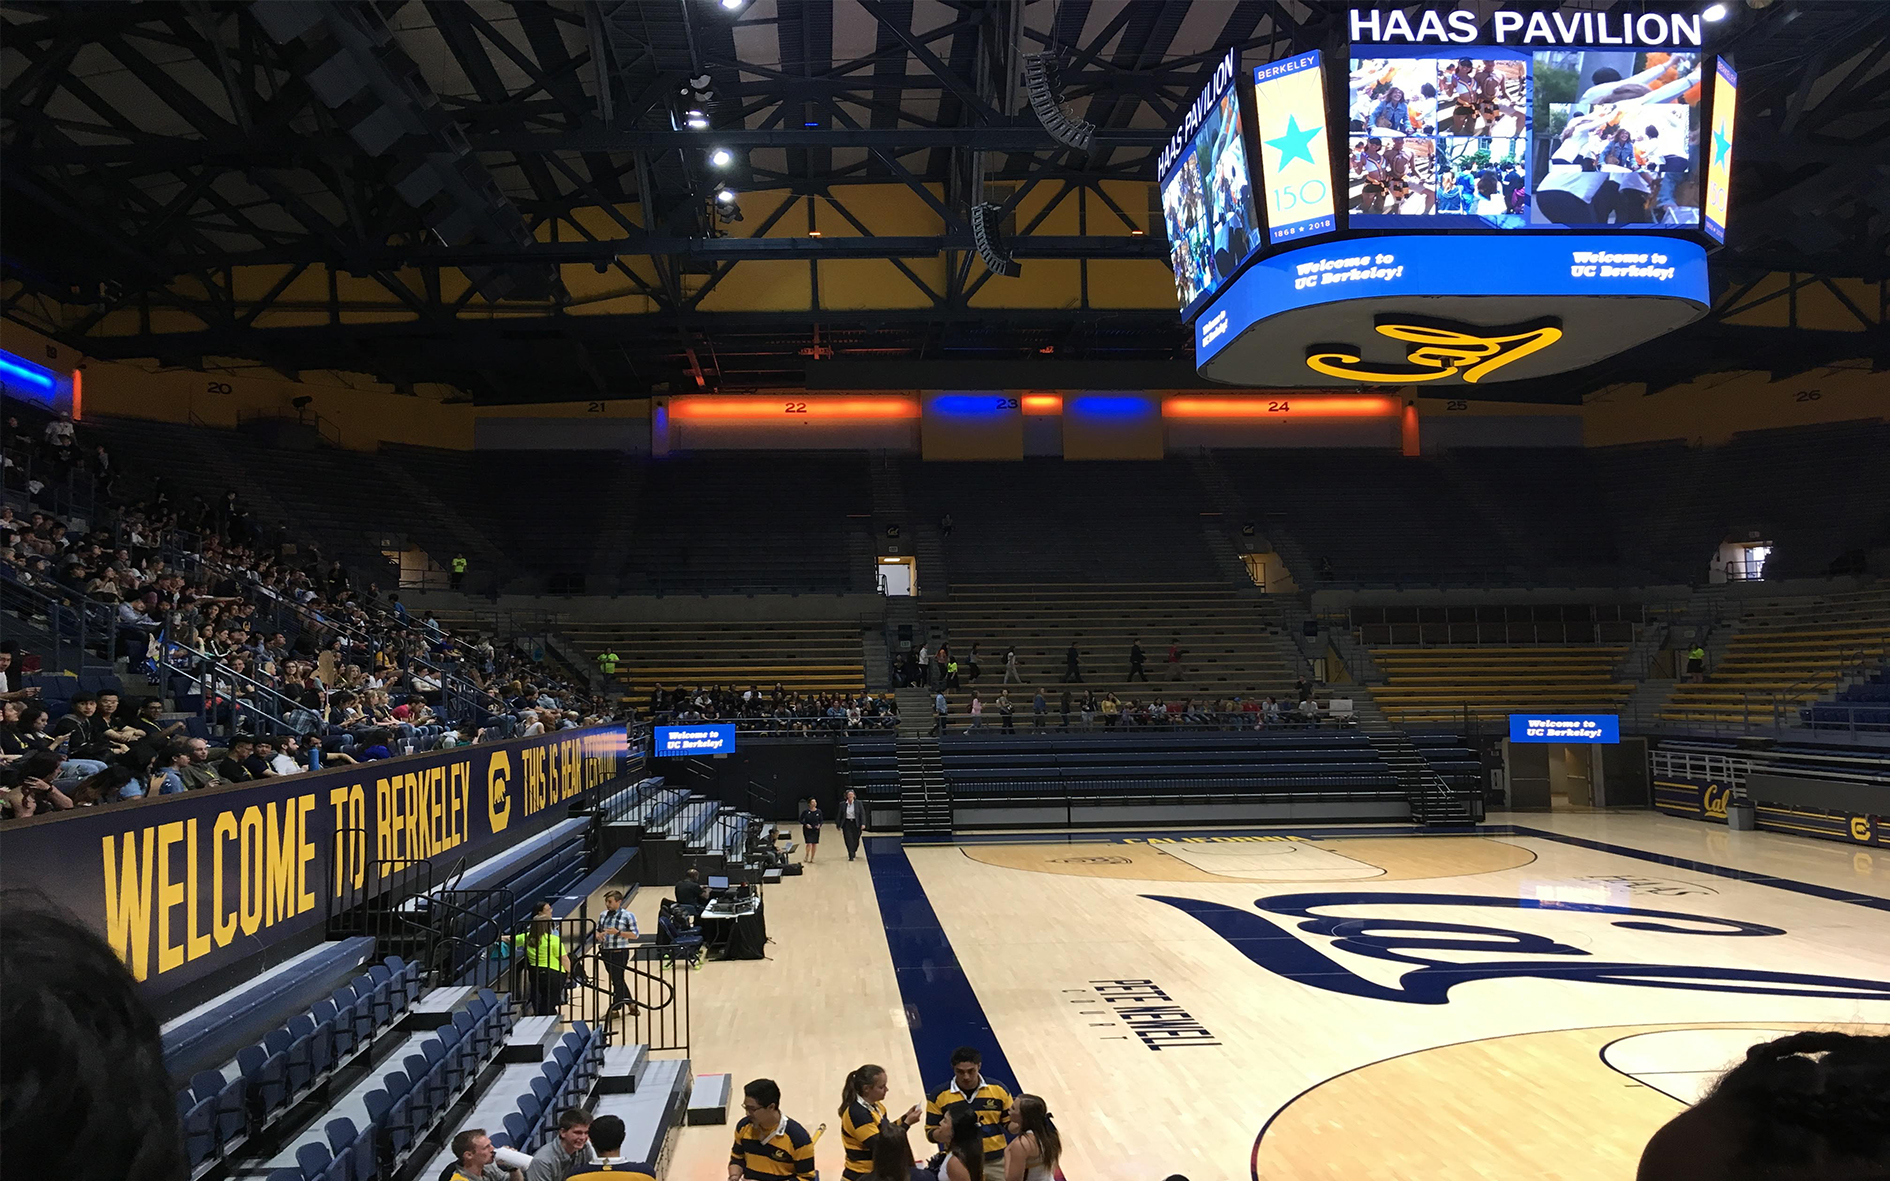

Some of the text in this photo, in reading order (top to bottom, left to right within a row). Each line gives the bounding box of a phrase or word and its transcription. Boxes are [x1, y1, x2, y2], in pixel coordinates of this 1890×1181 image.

[1350, 9, 1702, 46] HAAS PAVILION
[1258, 56, 1315, 80] BERKELEY
[1157, 47, 1234, 181] HAAS PAVILION
[1273, 179, 1327, 211] 150
[1273, 219, 1331, 238] 1868 2018
[1296, 253, 1394, 276] Welcome to
[1572, 251, 1668, 265] Welcome to
[1294, 265, 1404, 290] UC Berkeley!
[1570, 264, 1675, 281] UC Berkeley!
[207, 382, 232, 395] 20
[1795, 390, 1821, 402] 26
[587, 402, 606, 413] 21
[785, 400, 807, 412] 22
[996, 398, 1018, 409] 23
[1268, 401, 1290, 412] 24
[1447, 400, 1468, 411] 25
[1528, 719, 1596, 728] Welcome to
[668, 730, 719, 740] Welcome to
[1526, 728, 1602, 739] UC Berkeley!
[667, 739, 723, 749] UC Berkeley!
[1704, 784, 1729, 818] Cal
[103, 793, 317, 982] WELCOME
[330, 784, 365, 898] TO
[376, 761, 471, 879] BERKELEY
[521, 745, 546, 817] THIS
[549, 743, 559, 806] IS
[561, 738, 582, 800] BEAR
